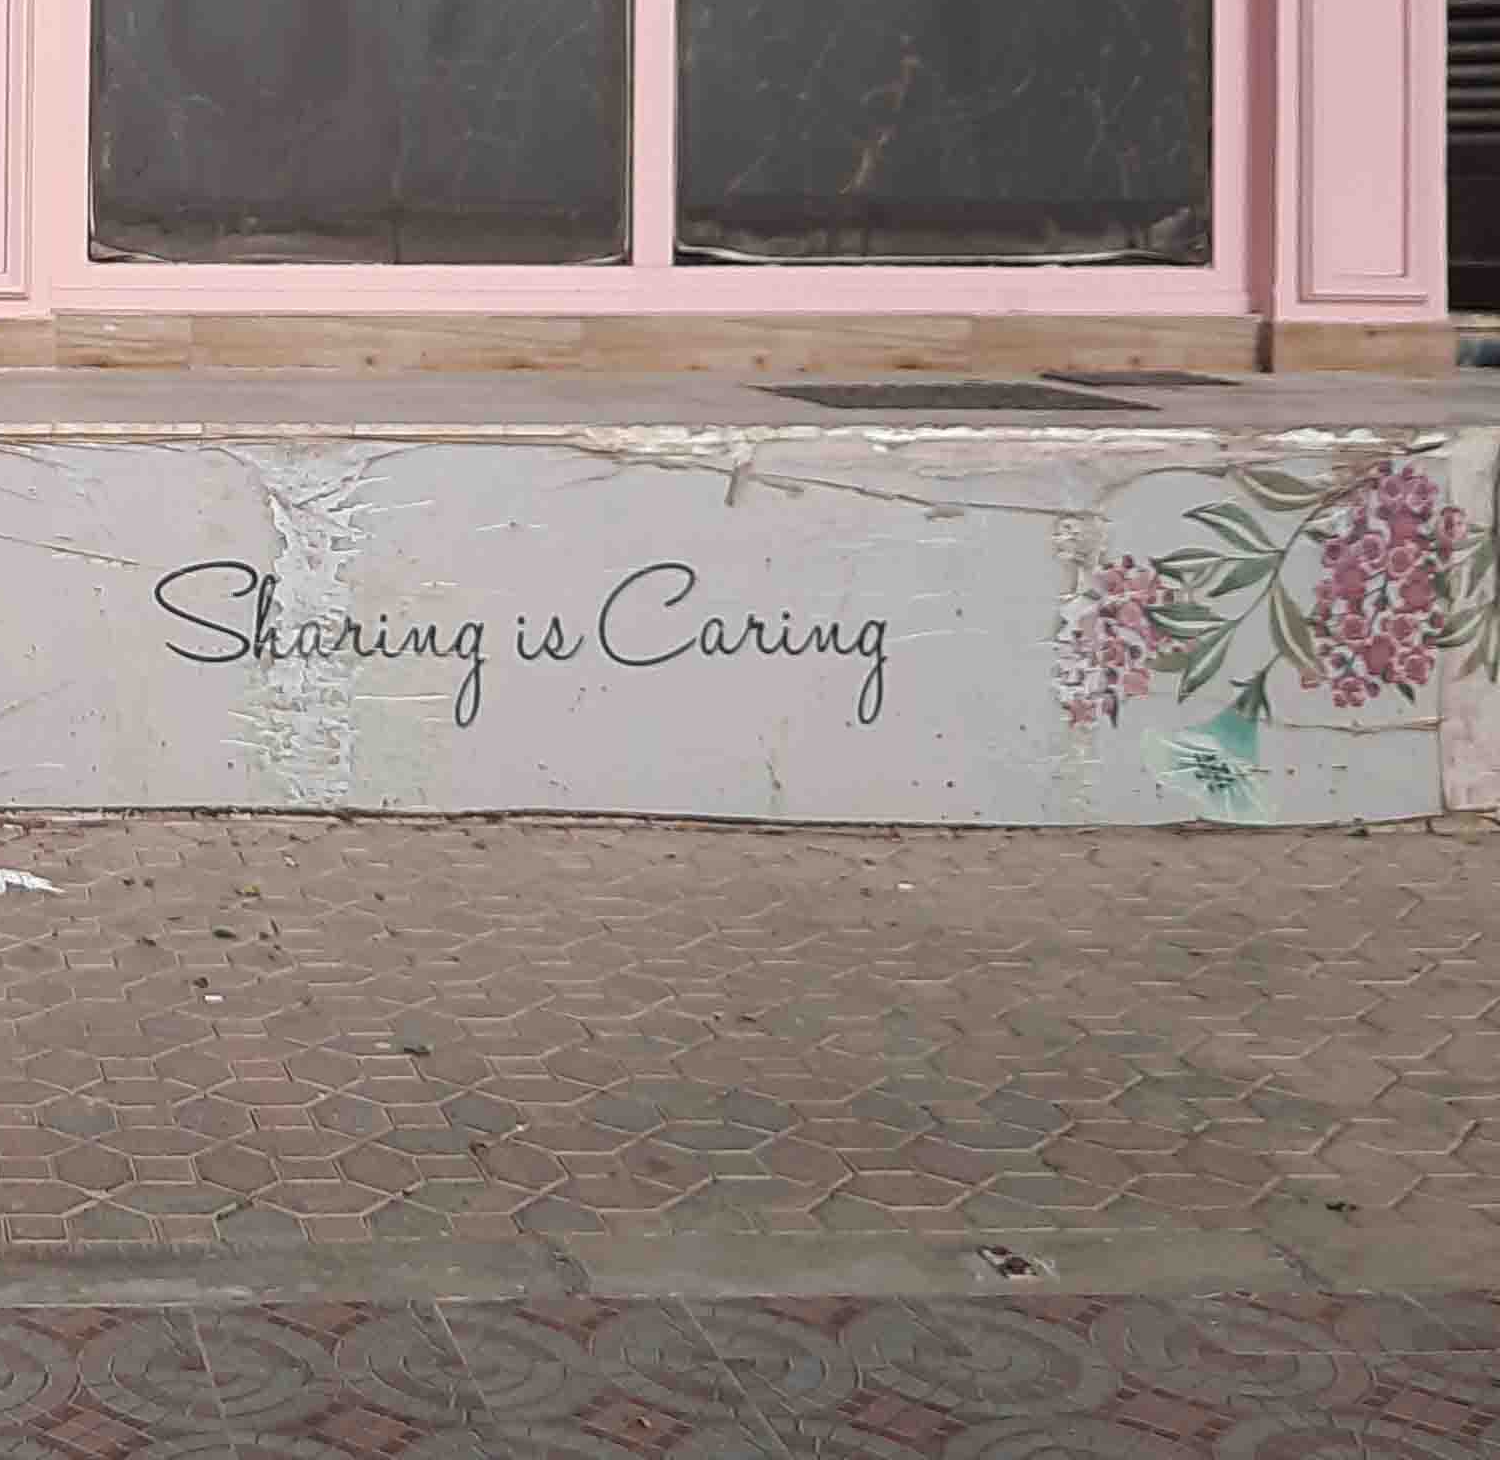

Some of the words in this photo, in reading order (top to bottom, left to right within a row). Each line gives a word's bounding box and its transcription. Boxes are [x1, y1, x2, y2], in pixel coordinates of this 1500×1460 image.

[154, 561, 486, 727] Sharing
[517, 614, 585, 661] is
[598, 562, 888, 726] Caring
